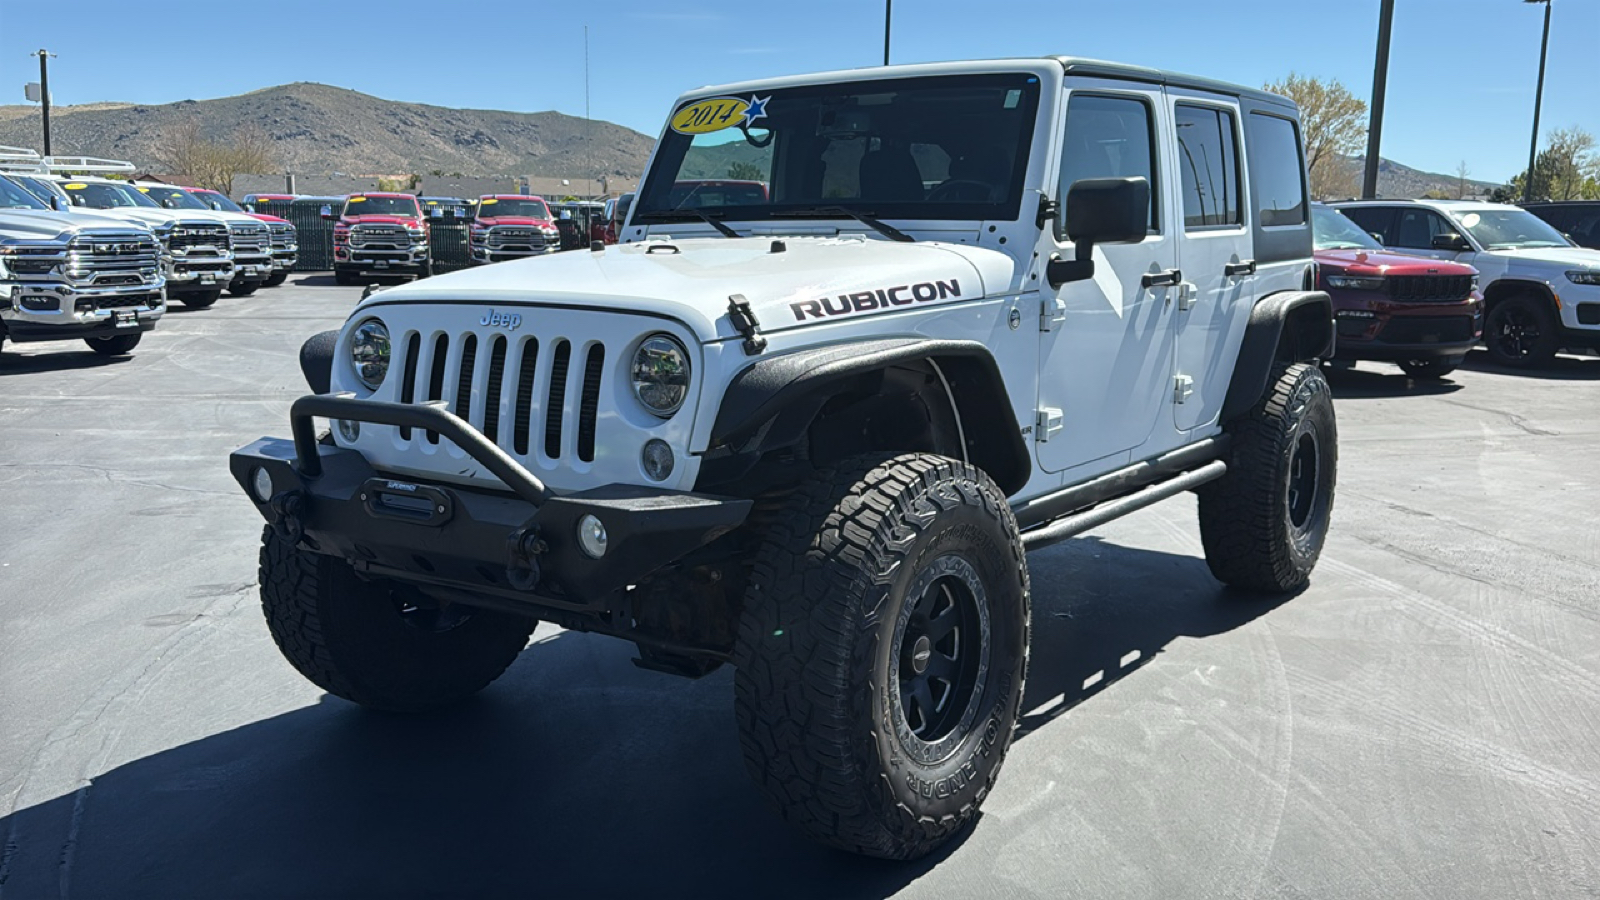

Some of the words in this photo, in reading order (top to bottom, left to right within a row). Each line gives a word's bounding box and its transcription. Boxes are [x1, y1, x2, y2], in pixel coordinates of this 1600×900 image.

[680, 102, 739, 128] 2014
[790, 279, 961, 321] RUBICON
[480, 309, 521, 331] Jeep
